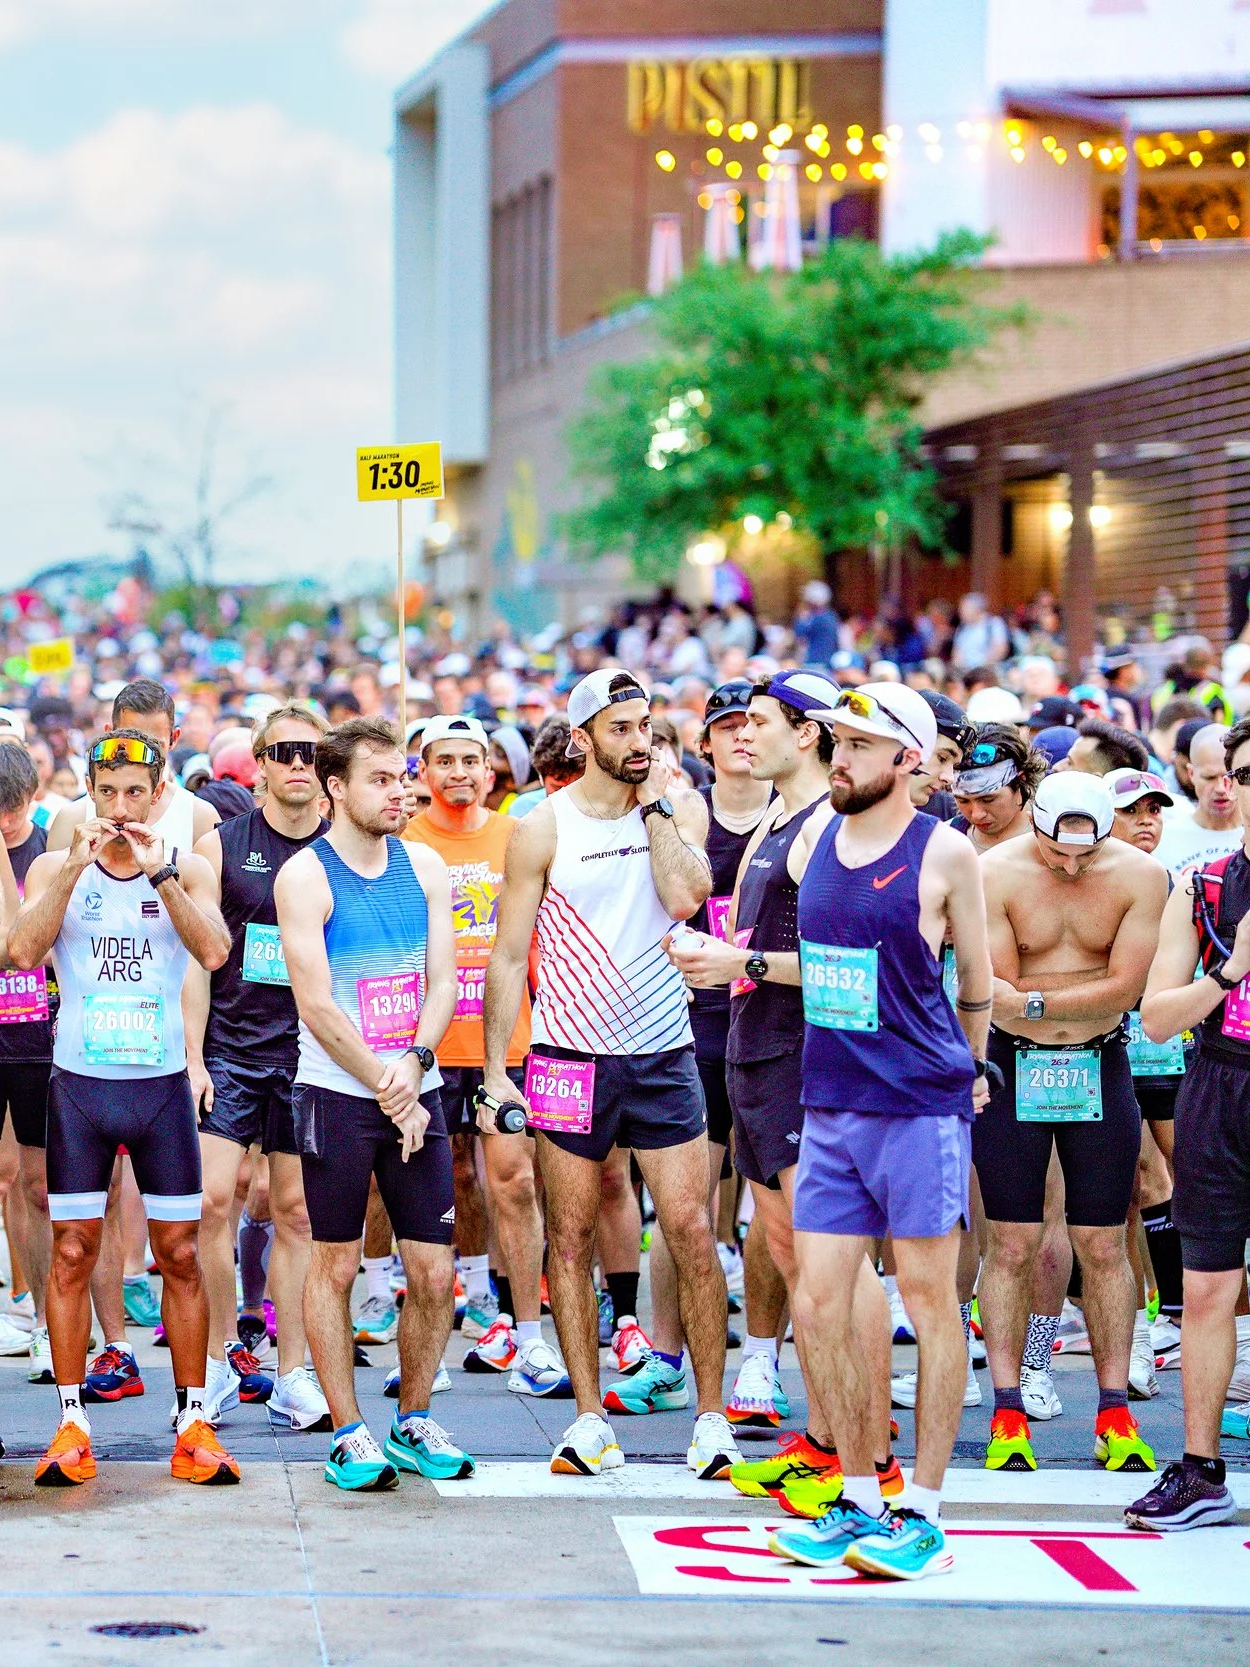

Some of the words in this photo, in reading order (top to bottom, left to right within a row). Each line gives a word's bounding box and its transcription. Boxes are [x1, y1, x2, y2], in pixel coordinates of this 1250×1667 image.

[369, 460, 420, 490] 1:30
[581, 849, 618, 862] COMPLETELY
[91, 936, 153, 961] VIDELA
[97, 959, 142, 982] ARG
[806, 962, 867, 991] 26532
[370, 991, 417, 1017] 13296
[93, 1011, 156, 1032] 26002
[1051, 1059, 1071, 1067] 26.2
[1052, 1052, 1093, 1060] MARATHON
[531, 1073, 583, 1099] 13264
[1029, 1068, 1090, 1088] 26371
